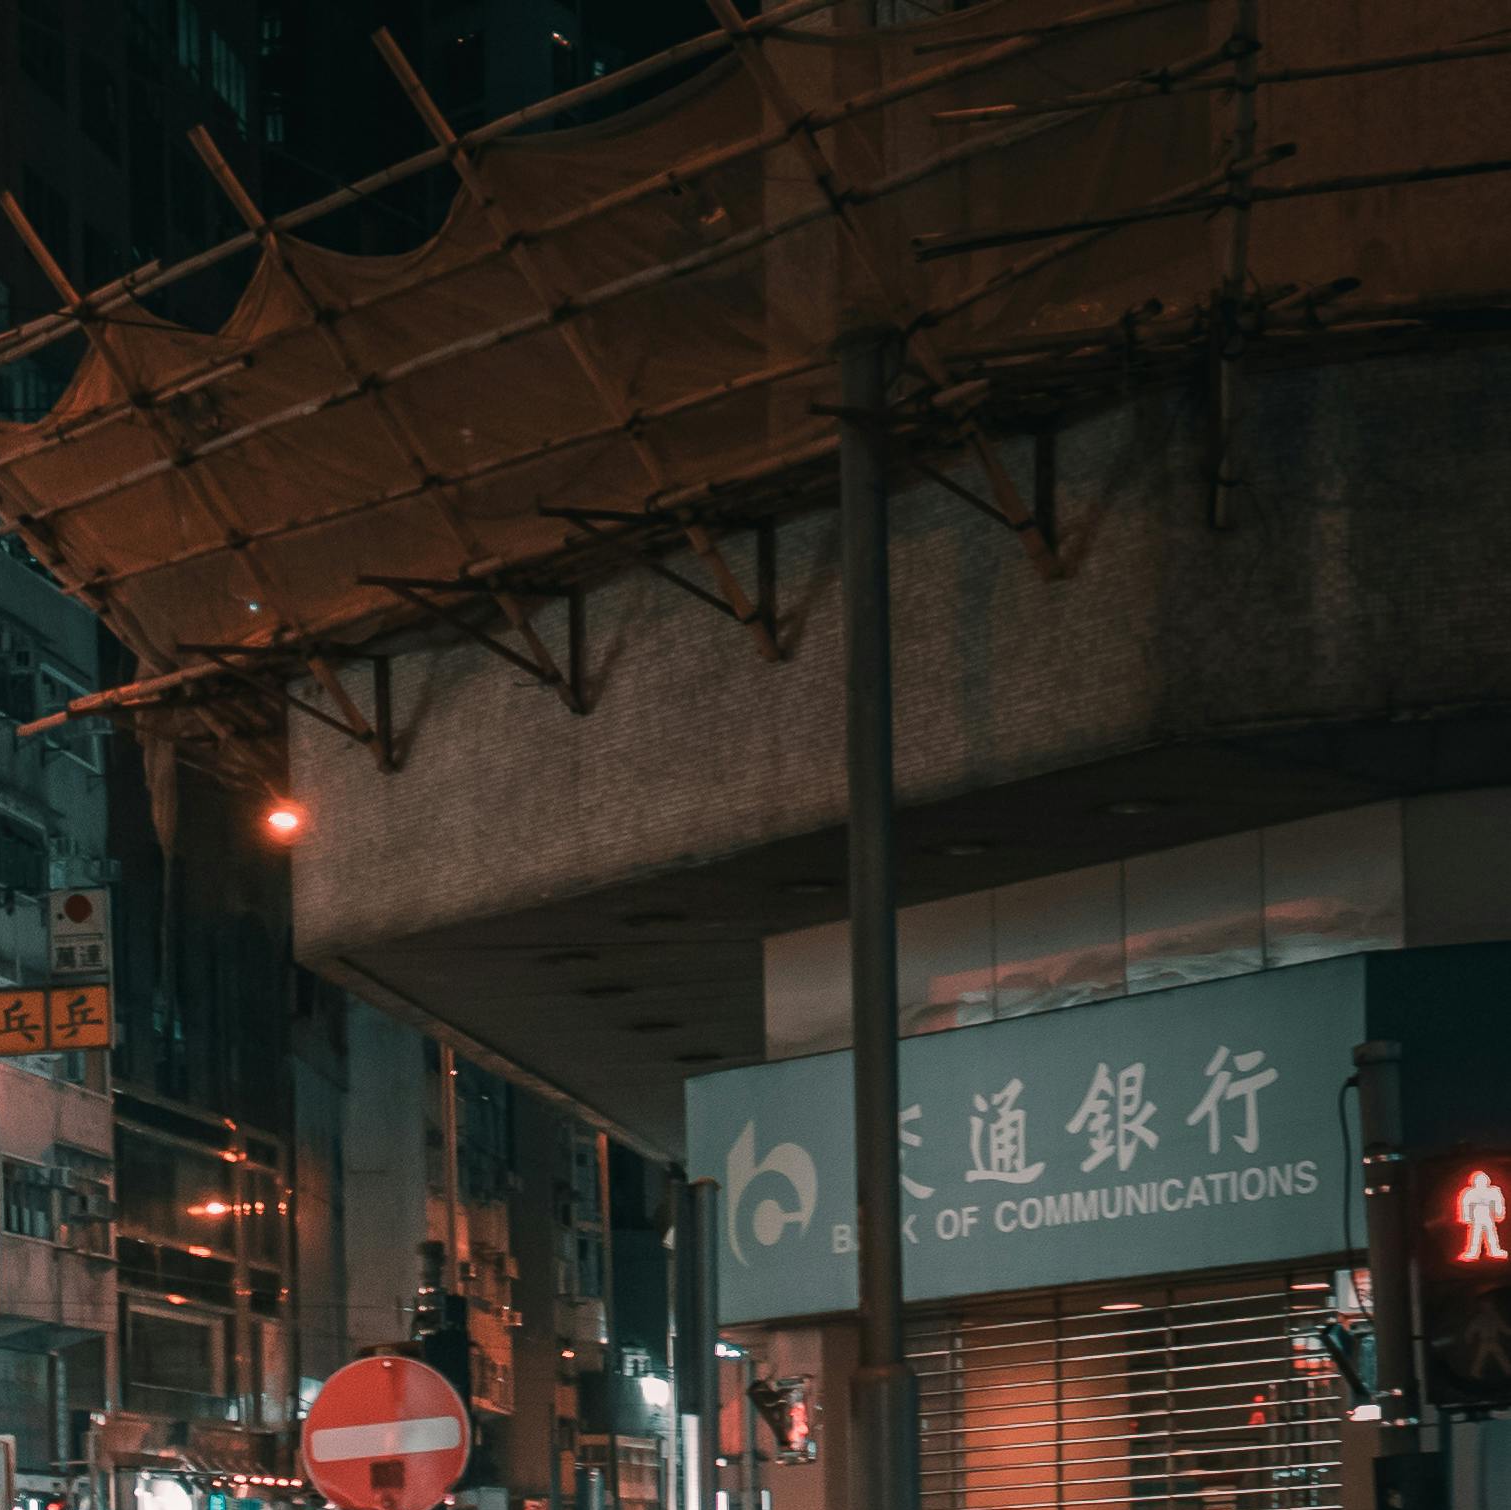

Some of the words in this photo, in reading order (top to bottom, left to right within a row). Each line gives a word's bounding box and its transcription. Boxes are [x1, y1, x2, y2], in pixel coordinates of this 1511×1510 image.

[832, 1214, 920, 1254] BK
[935, 1206, 981, 1241] OF
[994, 1160, 1320, 1233] COMMUNICATIONS
